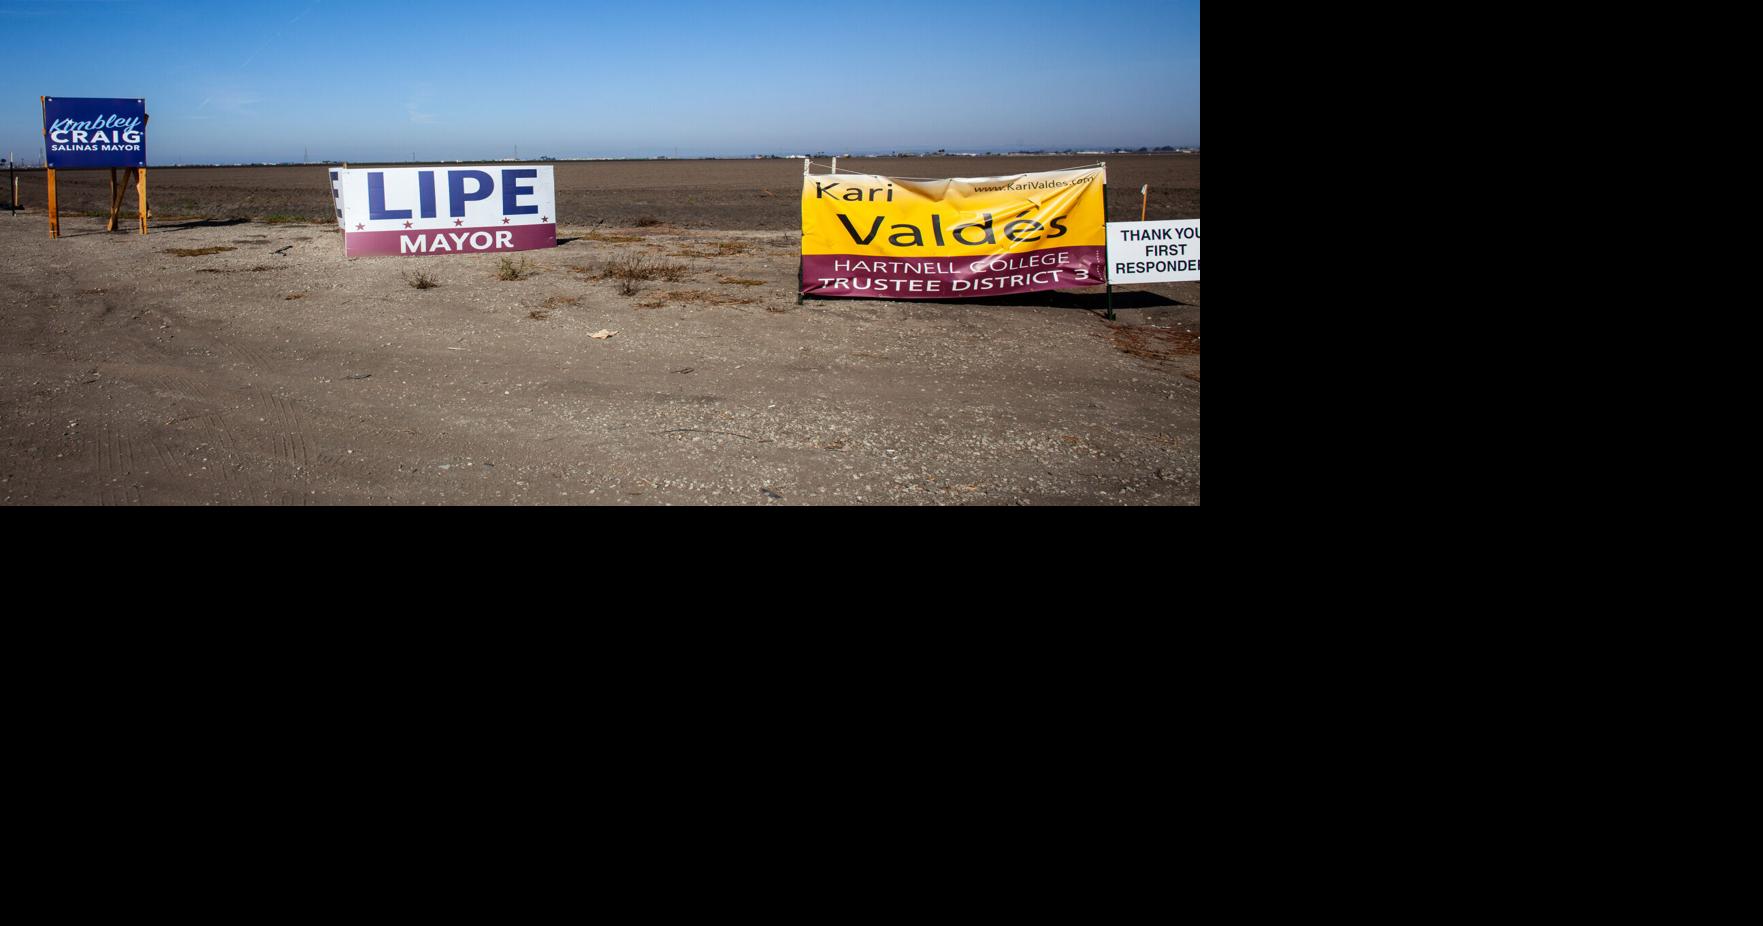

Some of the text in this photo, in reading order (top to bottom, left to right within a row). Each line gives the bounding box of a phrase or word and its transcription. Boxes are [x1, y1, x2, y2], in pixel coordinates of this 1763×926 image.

[49, 113, 141, 134] Kimbley
[50, 130, 141, 143] CRAIG
[367, 168, 539, 220] LIPE
[815, 181, 894, 203] Kari
[973, 176, 1095, 194] www.KariValdes.com
[836, 209, 1069, 247] Valdés
[1120, 228, 1172, 242] THANK
[400, 230, 514, 254] MAYOR
[1145, 243, 1187, 257] FIRST
[834, 251, 1070, 274] HARTNELL COLLEGE
[1115, 259, 1200, 275] RESPONDE
[818, 268, 1089, 292] TRUSTEE DISTRICT 3
